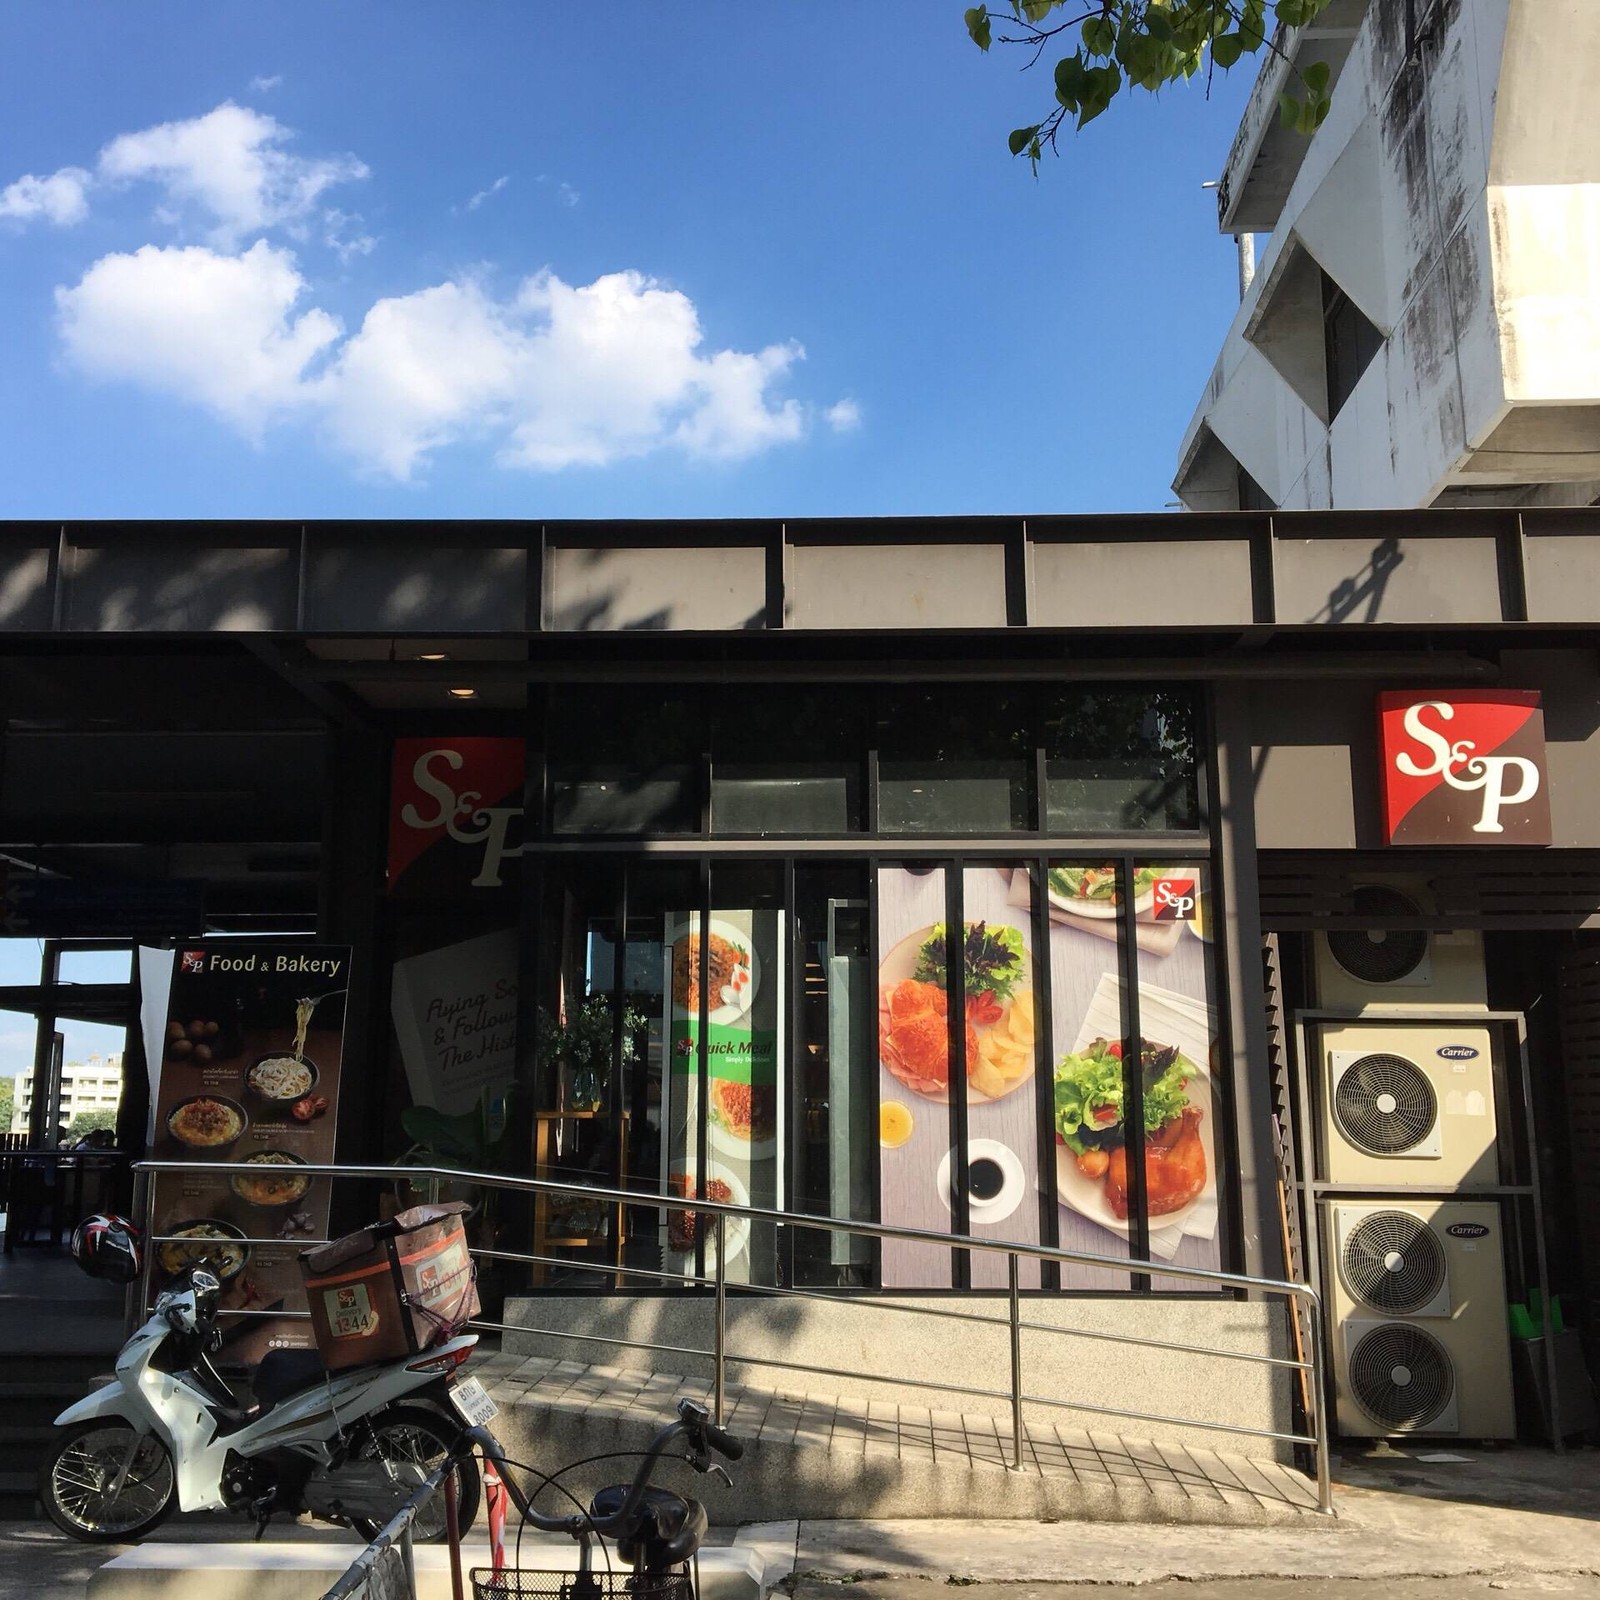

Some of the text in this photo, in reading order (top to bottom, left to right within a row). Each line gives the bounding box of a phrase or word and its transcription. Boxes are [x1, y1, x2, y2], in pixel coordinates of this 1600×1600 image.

[1395, 700, 1540, 833] S&P
[1156, 881, 1194, 918] S&P
[183, 951, 341, 978] S&P Food & Bakery
[738, 1041, 773, 1055] Meal
[1441, 1047, 1475, 1057] Carrier
[438, 1046, 474, 1071] The
[1451, 1225, 1485, 1235] Carrier
[339, 1291, 355, 1307] S&P
[335, 1314, 369, 1333] 1344
